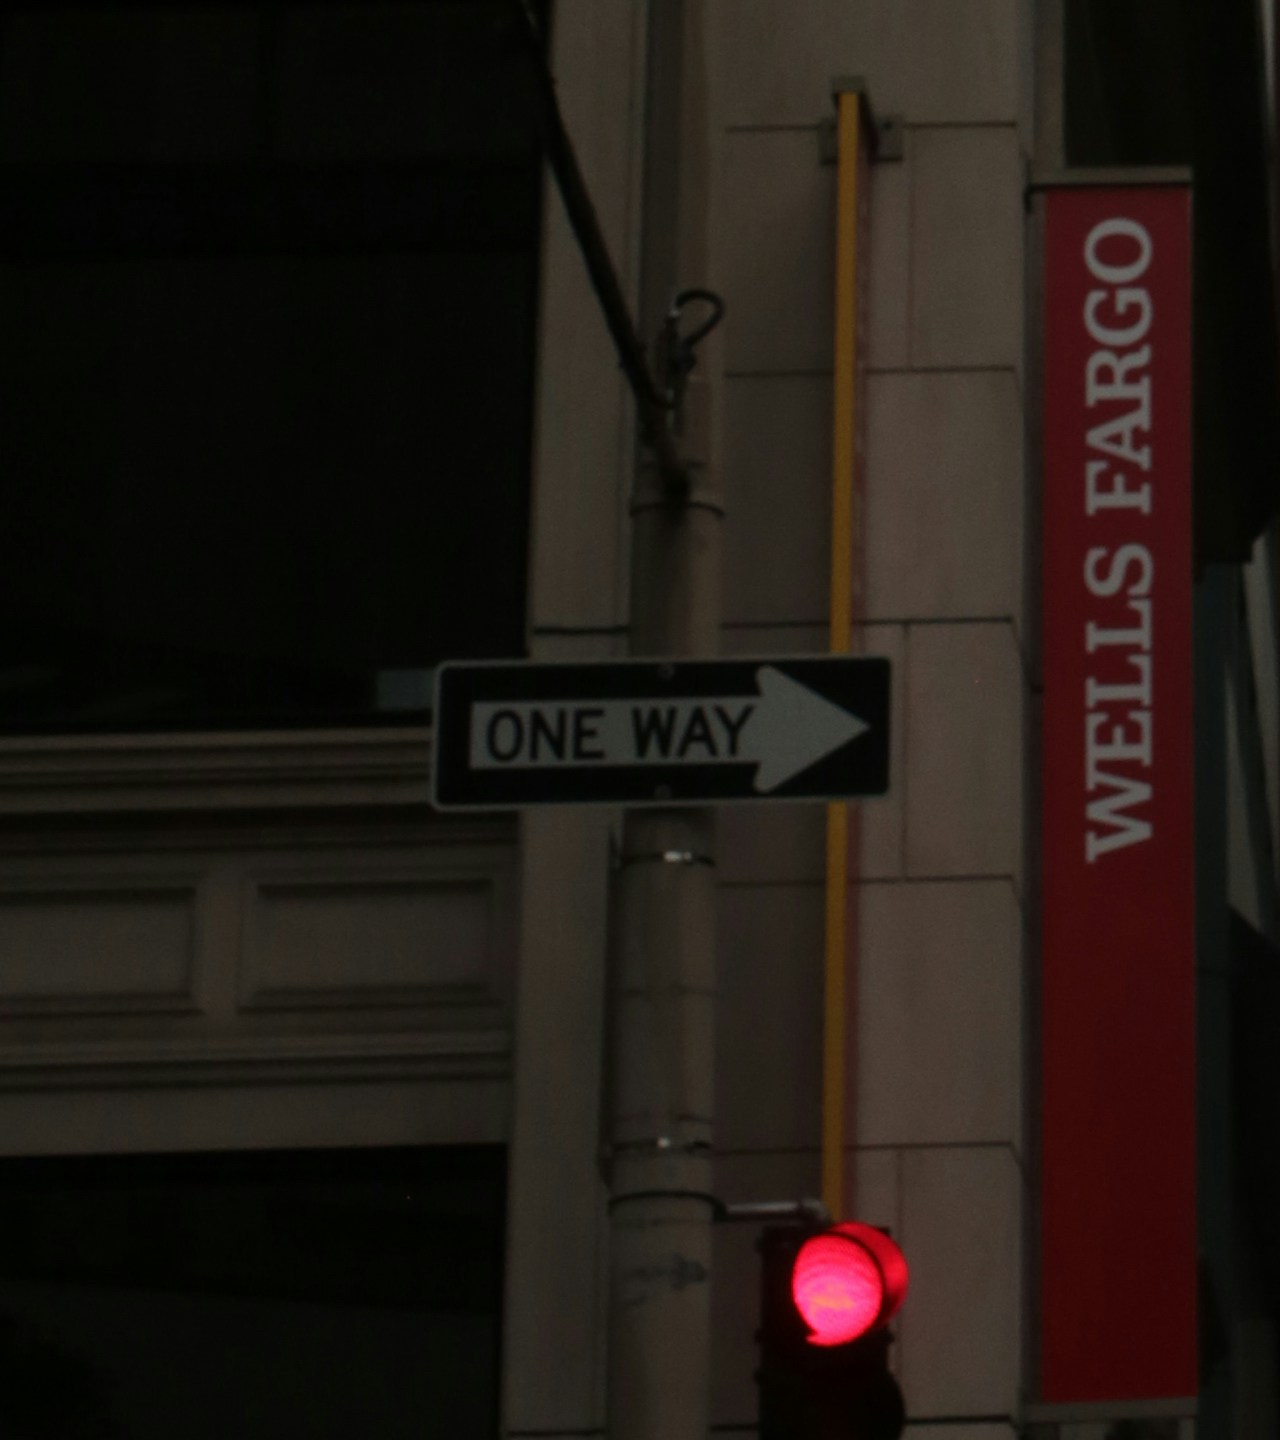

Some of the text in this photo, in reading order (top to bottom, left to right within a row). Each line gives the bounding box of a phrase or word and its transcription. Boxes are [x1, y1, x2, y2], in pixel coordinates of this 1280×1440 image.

[1084, 216, 1154, 864] WELLS FARGO
[486, 703, 754, 762] ONE WAY
